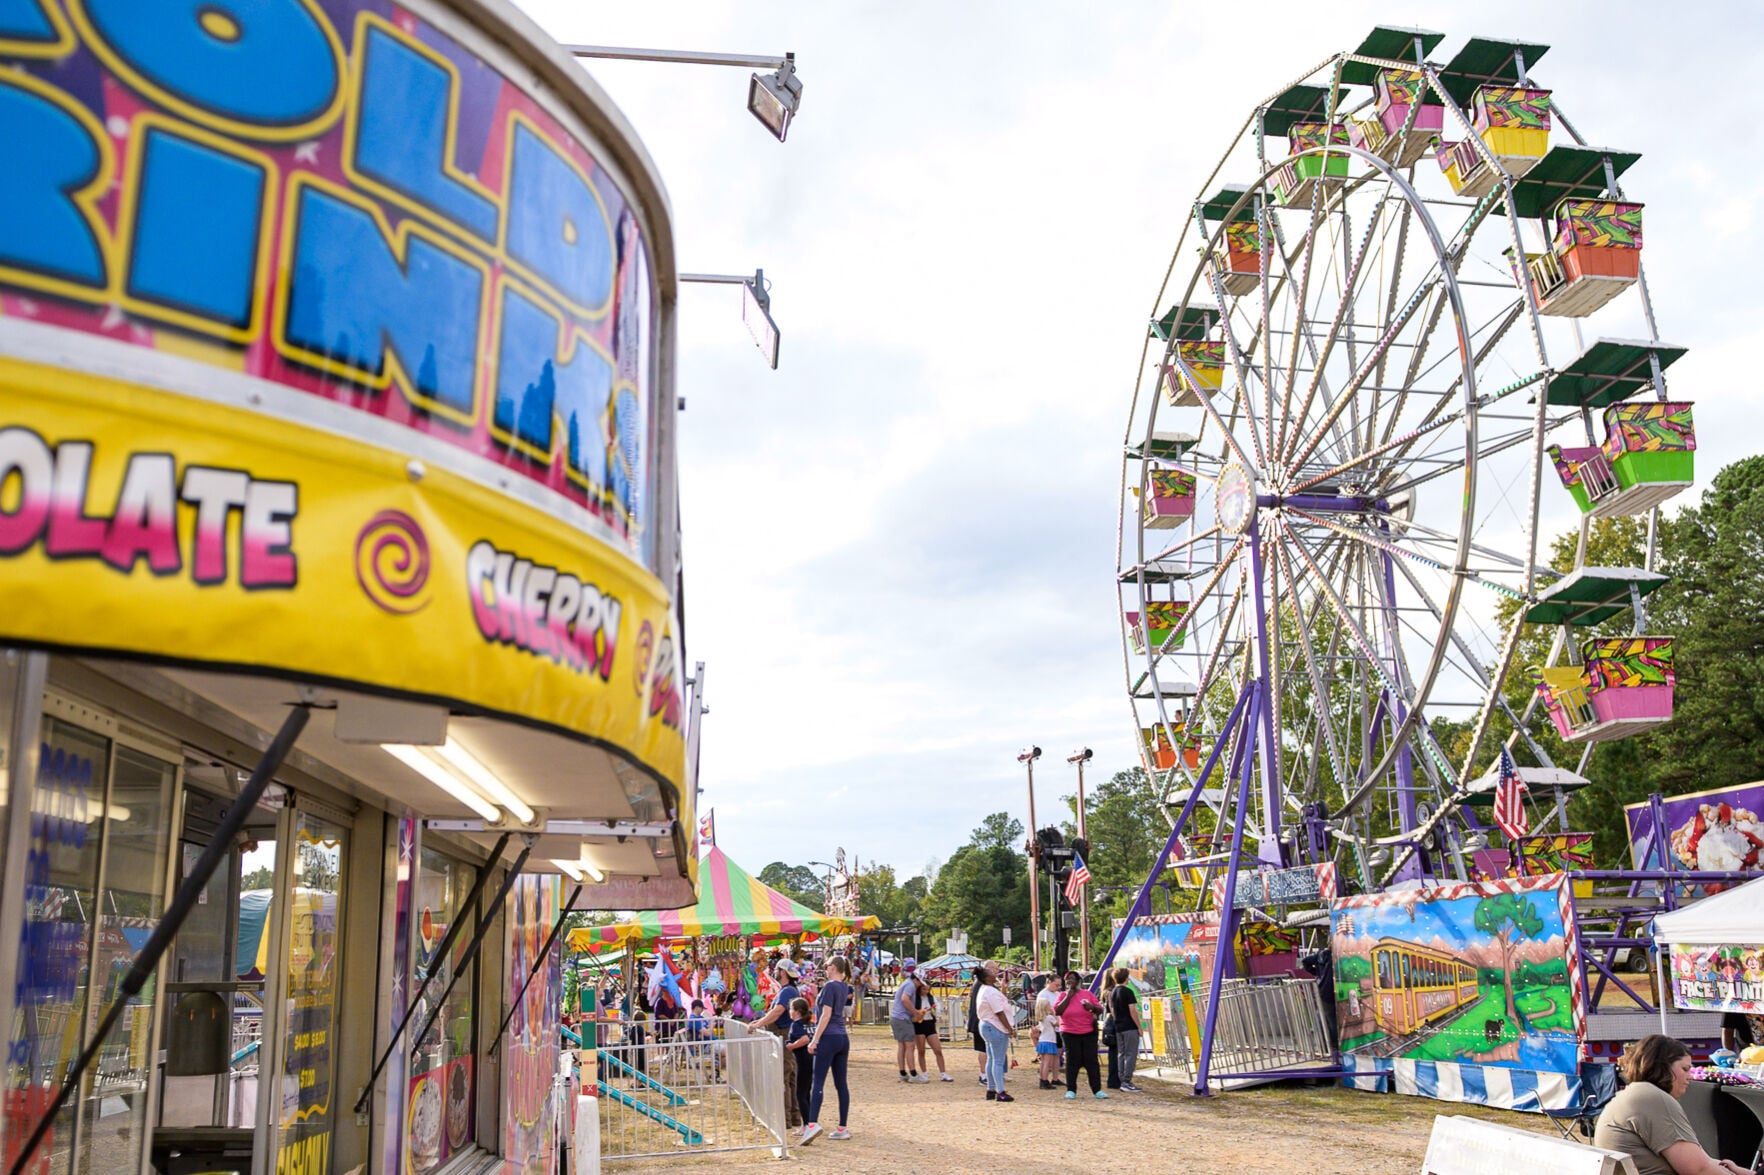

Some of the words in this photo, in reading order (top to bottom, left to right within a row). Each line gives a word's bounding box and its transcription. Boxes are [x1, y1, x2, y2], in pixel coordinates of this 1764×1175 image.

[0, 0, 616, 321] OLD
[467, 539, 622, 683] CHERRY
[1679, 978, 1716, 999] FACE
